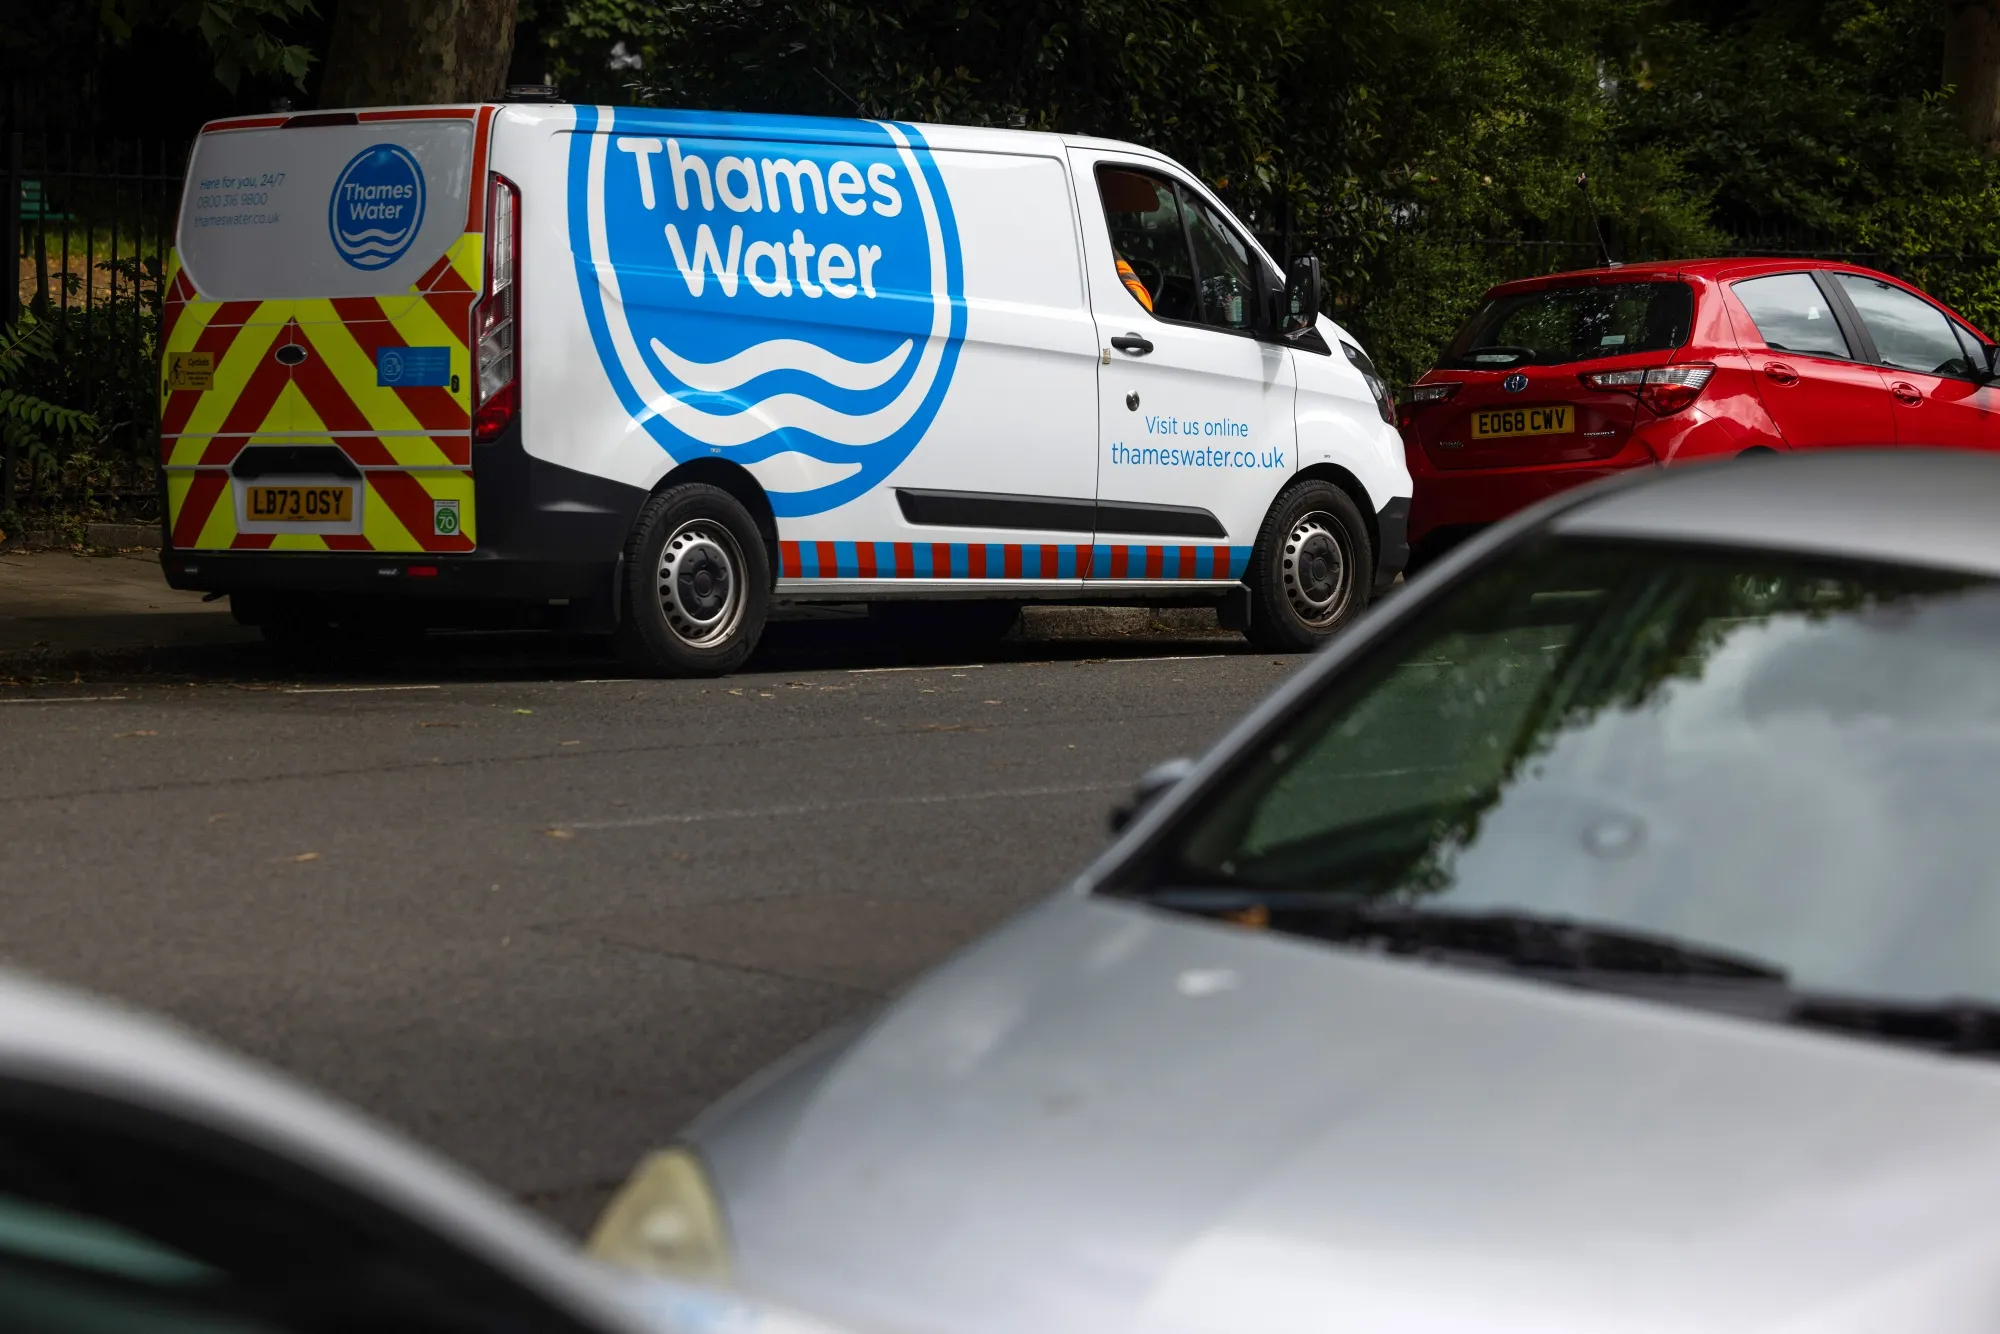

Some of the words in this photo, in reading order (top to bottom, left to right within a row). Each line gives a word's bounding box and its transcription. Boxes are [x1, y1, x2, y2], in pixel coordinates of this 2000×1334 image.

[200, 178, 221, 191] Here
[222, 175, 236, 189] for
[237, 176, 258, 190] you,
[260, 172, 286, 188] 24/7
[616, 136, 903, 218] Thames
[196, 194, 222, 210] 0800
[222, 193, 238, 207] 316
[240, 192, 268, 206] 9800
[344, 183, 413, 200] Thames
[194, 212, 281, 228] thameswater.co.uk
[350, 202, 404, 220] Water
[664, 223, 882, 299] Water
[1145, 415, 1178, 434] Visit
[1183, 420, 1200, 436] us
[1204, 418, 1249, 437] online
[1530, 408, 1566, 430] CWV
[1111, 441, 1285, 469] thameswater.co.uk
[253, 489, 301, 515] LB73
[305, 489, 344, 515] OSY
[438, 516, 455, 530] 70
